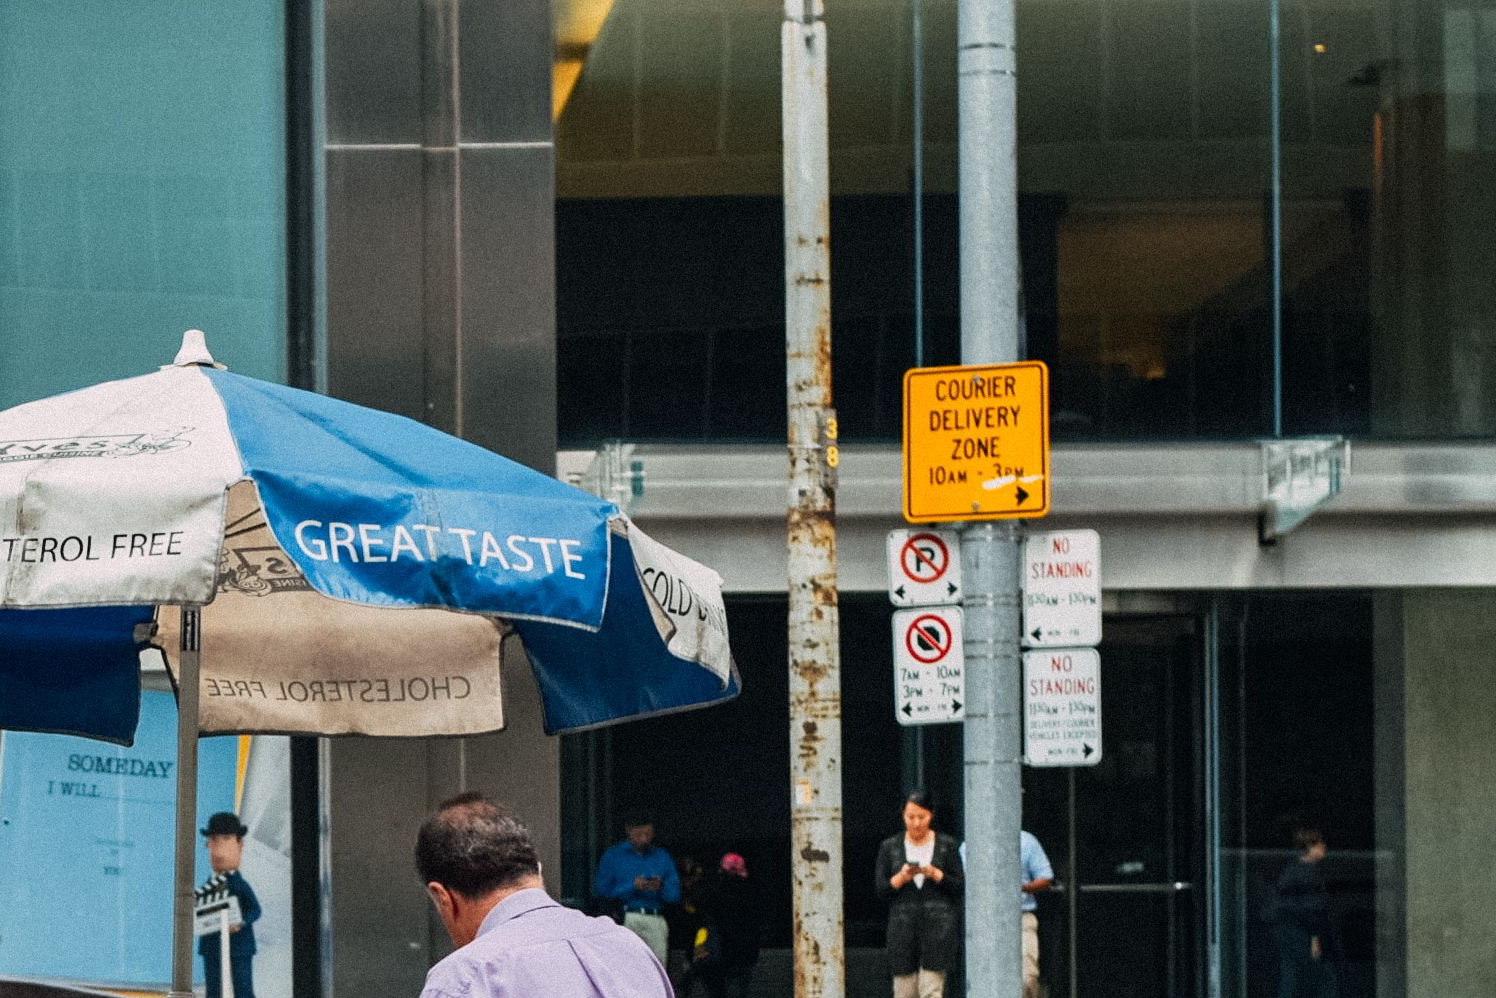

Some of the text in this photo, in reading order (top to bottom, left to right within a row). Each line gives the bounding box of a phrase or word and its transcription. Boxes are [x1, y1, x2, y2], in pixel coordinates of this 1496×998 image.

[936, 376, 1016, 401] COURIER
[930, 405, 1021, 431] DELIVERY
[951, 437, 1001, 460] ZONE
[929, 466, 967, 485] 10AM
[111, 530, 184, 560] FREE
[295, 519, 585, 580] GREAT TASTE
[1053, 538, 1070, 554] NO
[1032, 561, 1092, 579] STANDING
[643, 568, 692, 616] OLD
[1052, 656, 1072, 673] NO
[1030, 677, 1095, 696] STANDING
[67, 753, 173, 779] SOMEDAY
[47, 780, 102, 798] I WILL
